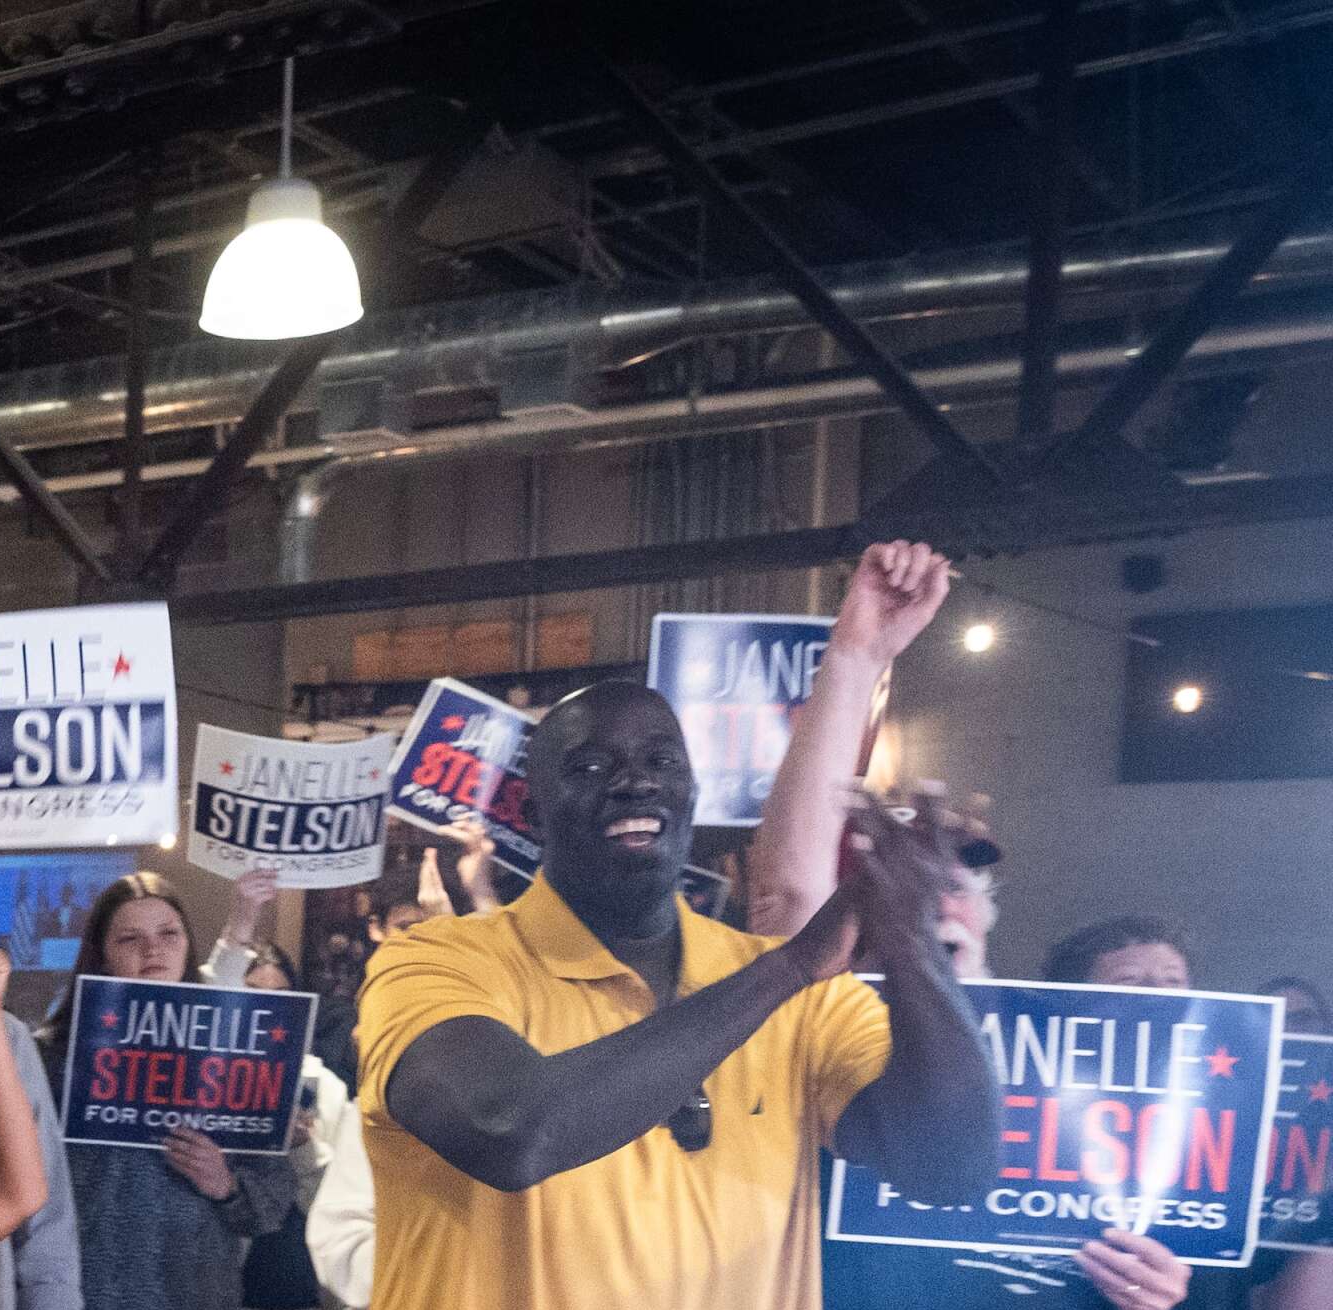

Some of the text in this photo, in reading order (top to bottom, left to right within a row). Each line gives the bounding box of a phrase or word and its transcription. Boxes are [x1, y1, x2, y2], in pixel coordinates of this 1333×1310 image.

[714, 640, 830, 700] JANE
[236, 753, 372, 801] JANELLE
[206, 840, 248, 861] FOR
[209, 792, 381, 852] STELSON
[117, 1000, 273, 1056] JANELLE
[982, 1012, 1207, 1098] ANELLE
[89, 1047, 283, 1111] STELSON
[83, 1104, 275, 1135] FOR CONGRESS
[997, 1094, 1236, 1195] ELSON
